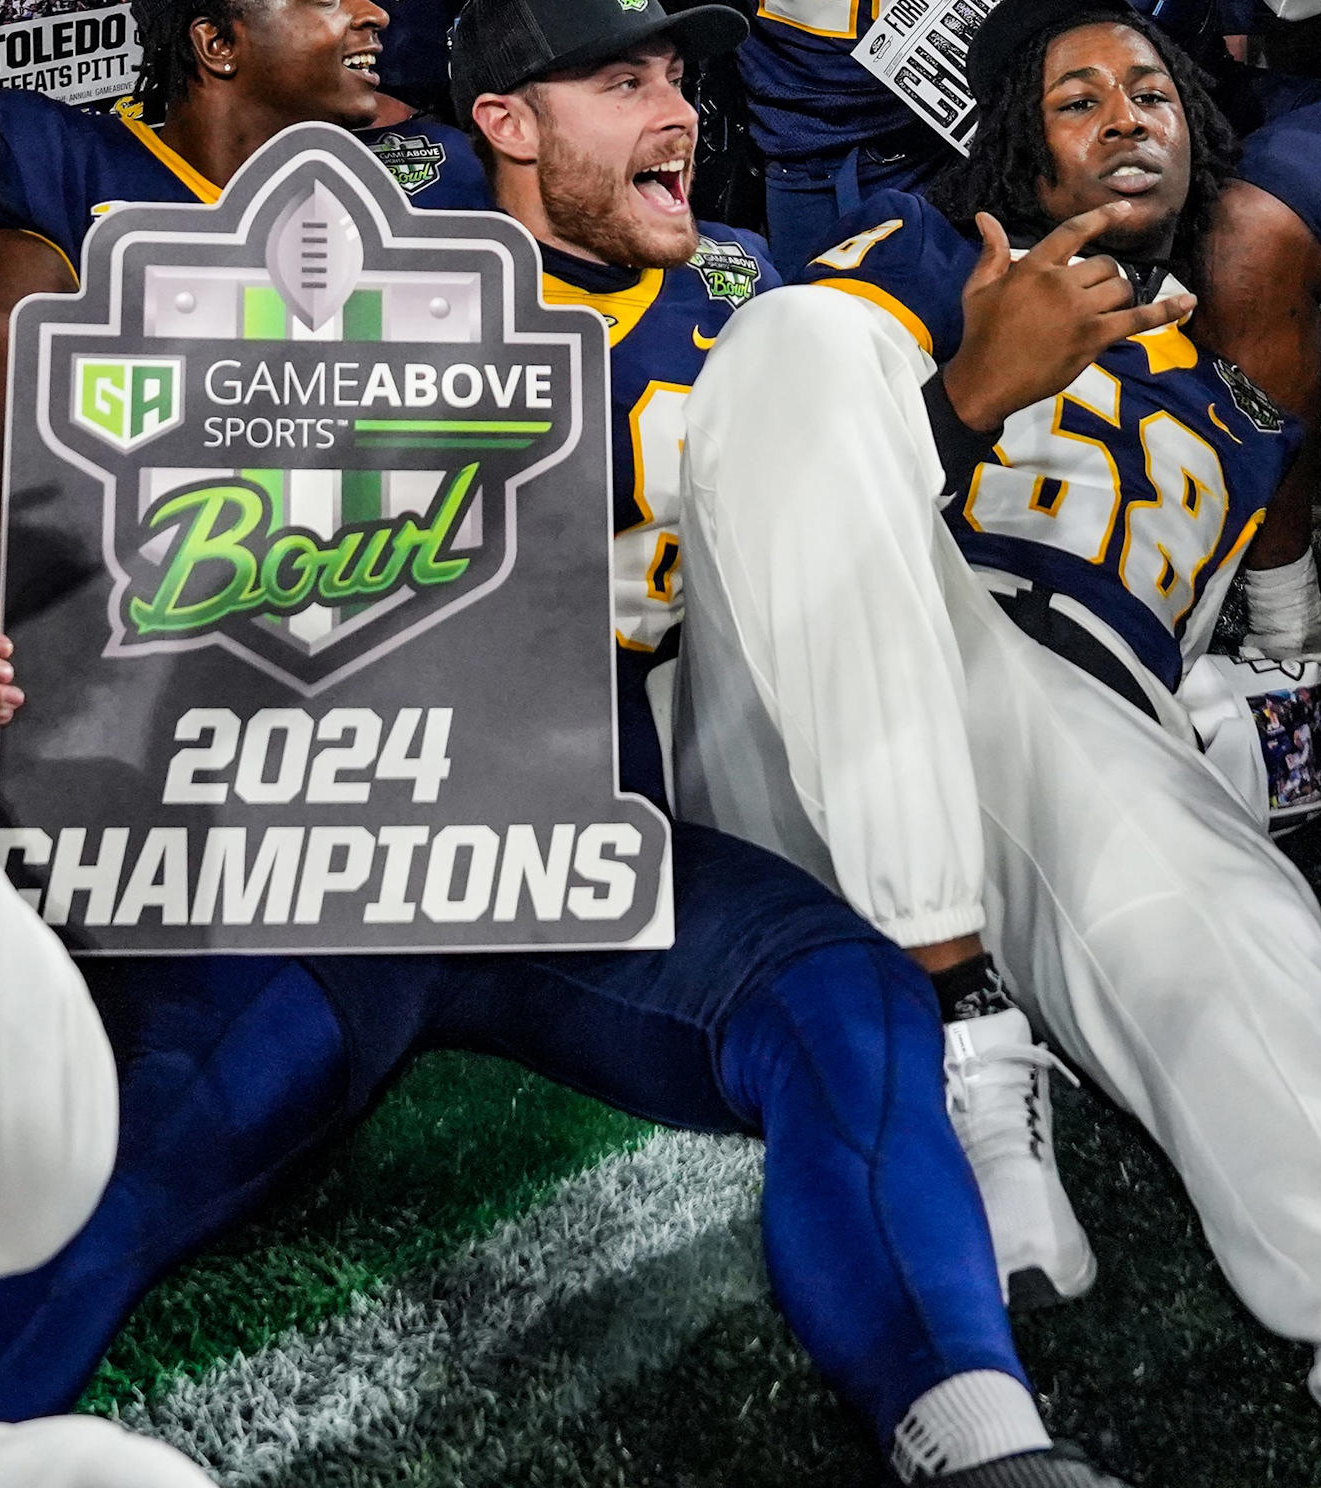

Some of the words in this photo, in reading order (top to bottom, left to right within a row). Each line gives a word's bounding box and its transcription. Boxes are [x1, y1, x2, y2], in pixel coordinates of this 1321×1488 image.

[378, 148, 440, 162] GAMEABOVE
[703, 254, 757, 271] GAMEABOVE
[708, 271, 755, 299] Bowl
[202, 358, 553, 411] GAMEABOVE
[964, 361, 1229, 632] 68
[129, 461, 480, 634] Bowl
[161, 706, 454, 806] 2024
